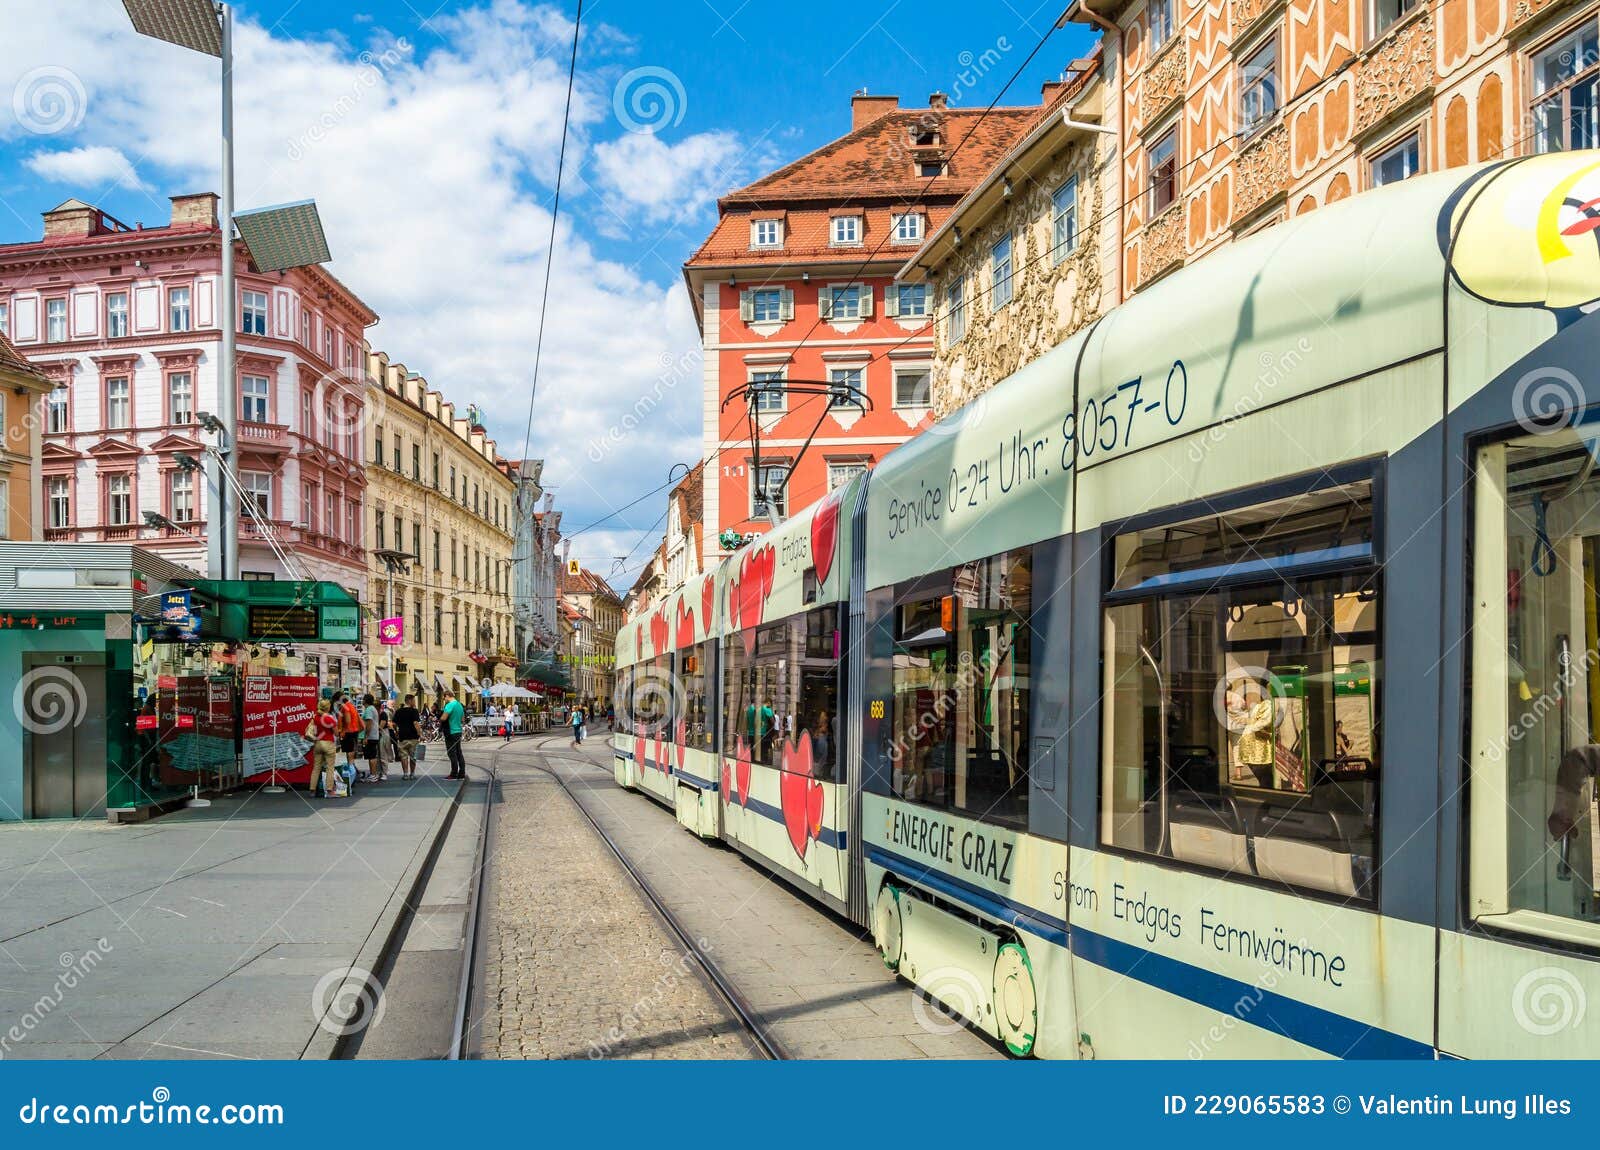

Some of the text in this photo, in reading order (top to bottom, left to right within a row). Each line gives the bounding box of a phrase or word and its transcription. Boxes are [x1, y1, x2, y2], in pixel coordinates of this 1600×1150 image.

[888, 359, 1188, 540] Service 0-24 Uhr: 8057-0
[782, 533, 807, 573] Erdgas
[570, 561, 579, 573] A
[168, 595, 185, 604] Jetzt
[53, 616, 77, 625] LIFT
[324, 619, 356, 627] GRAZ
[248, 681, 268, 691] Fund
[247, 691, 270, 700] Grube
[246, 712, 265, 722] Hier
[267, 709, 281, 717] am
[282, 703, 307, 714] Kiosk
[871, 700, 884, 719] 668
[287, 711, 316, 723] EURO!
[893, 810, 1016, 885] ENERGIE GRAZ
[1053, 870, 1346, 988] Strom Erdgas Fernwärme
